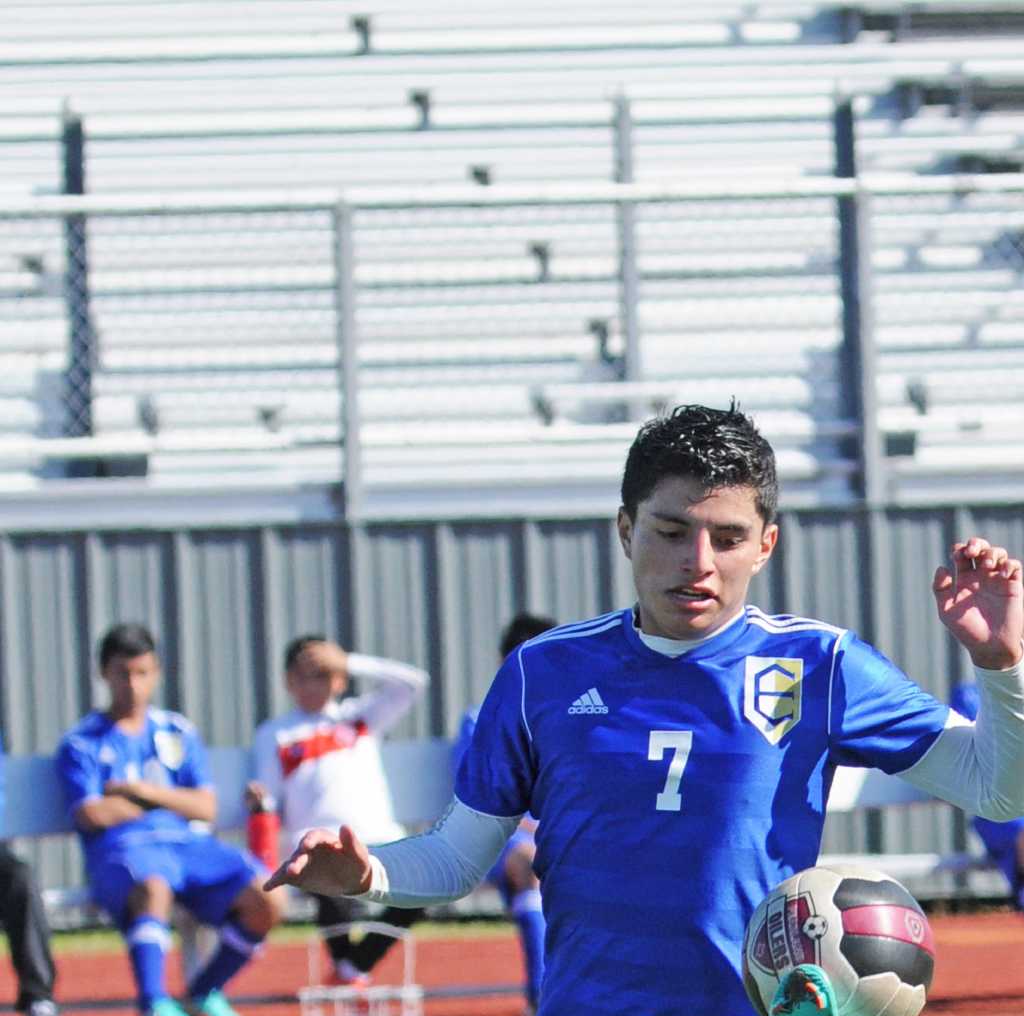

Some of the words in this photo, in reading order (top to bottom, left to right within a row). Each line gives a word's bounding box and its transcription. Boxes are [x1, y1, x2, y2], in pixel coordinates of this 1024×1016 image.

[568, 704, 609, 714] adidas
[648, 731, 693, 811] 7
[768, 911, 790, 970] OILERS
